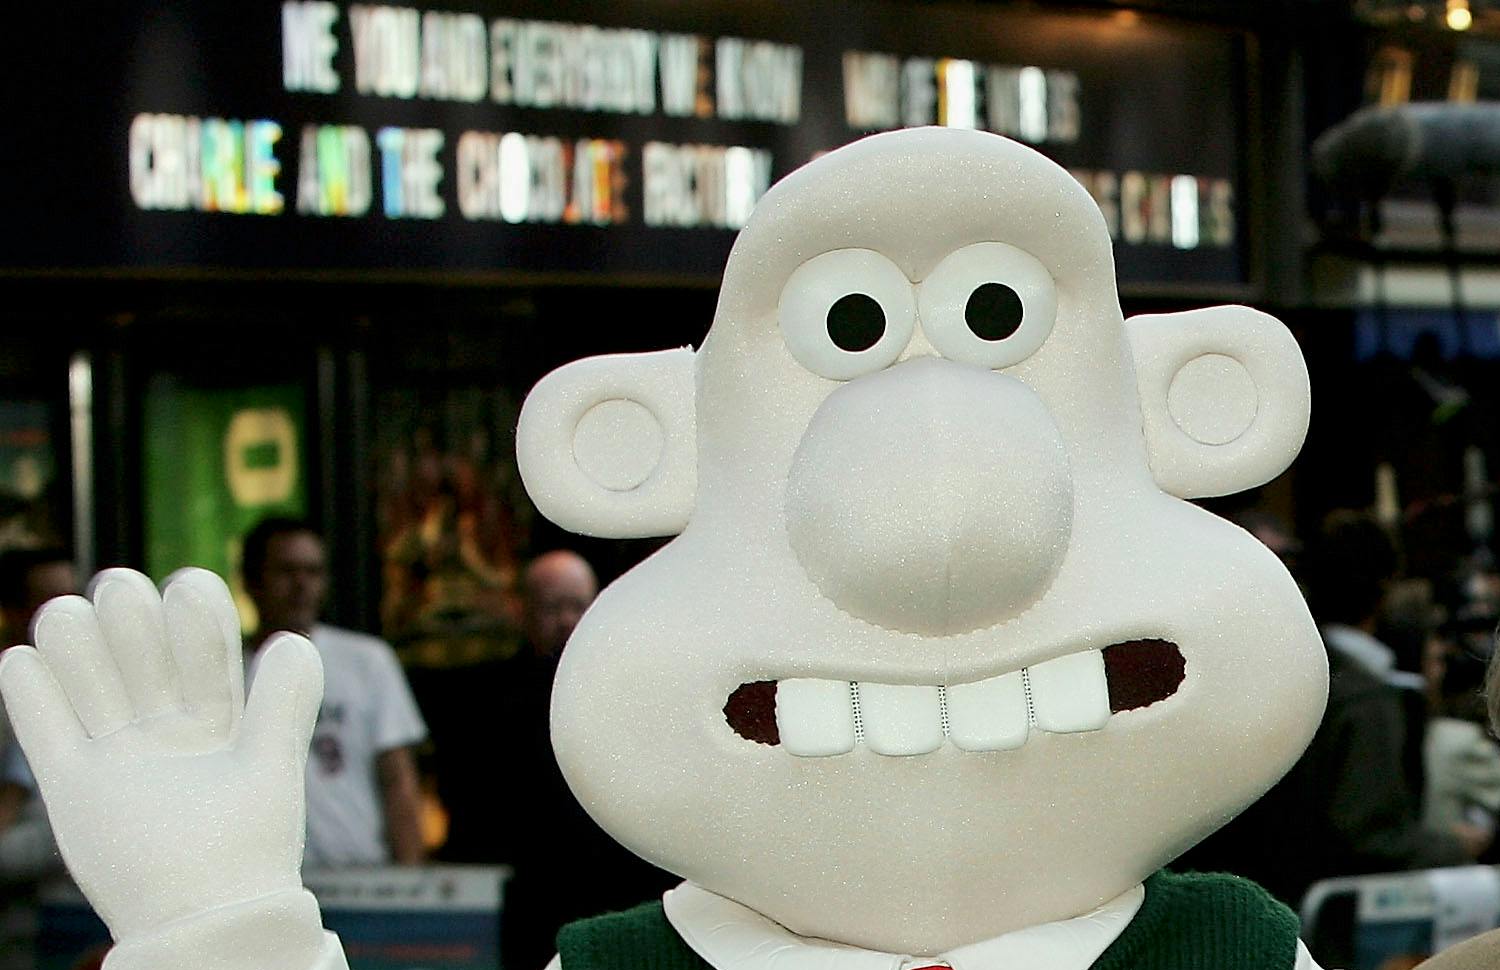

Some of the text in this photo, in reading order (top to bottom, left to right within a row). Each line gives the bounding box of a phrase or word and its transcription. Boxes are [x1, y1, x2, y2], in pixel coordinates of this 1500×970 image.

[129, 112, 284, 215] CHARLIE
[297, 121, 372, 217] AND
[376, 126, 446, 220] THE
[457, 131, 628, 224] CHOCOLATE
